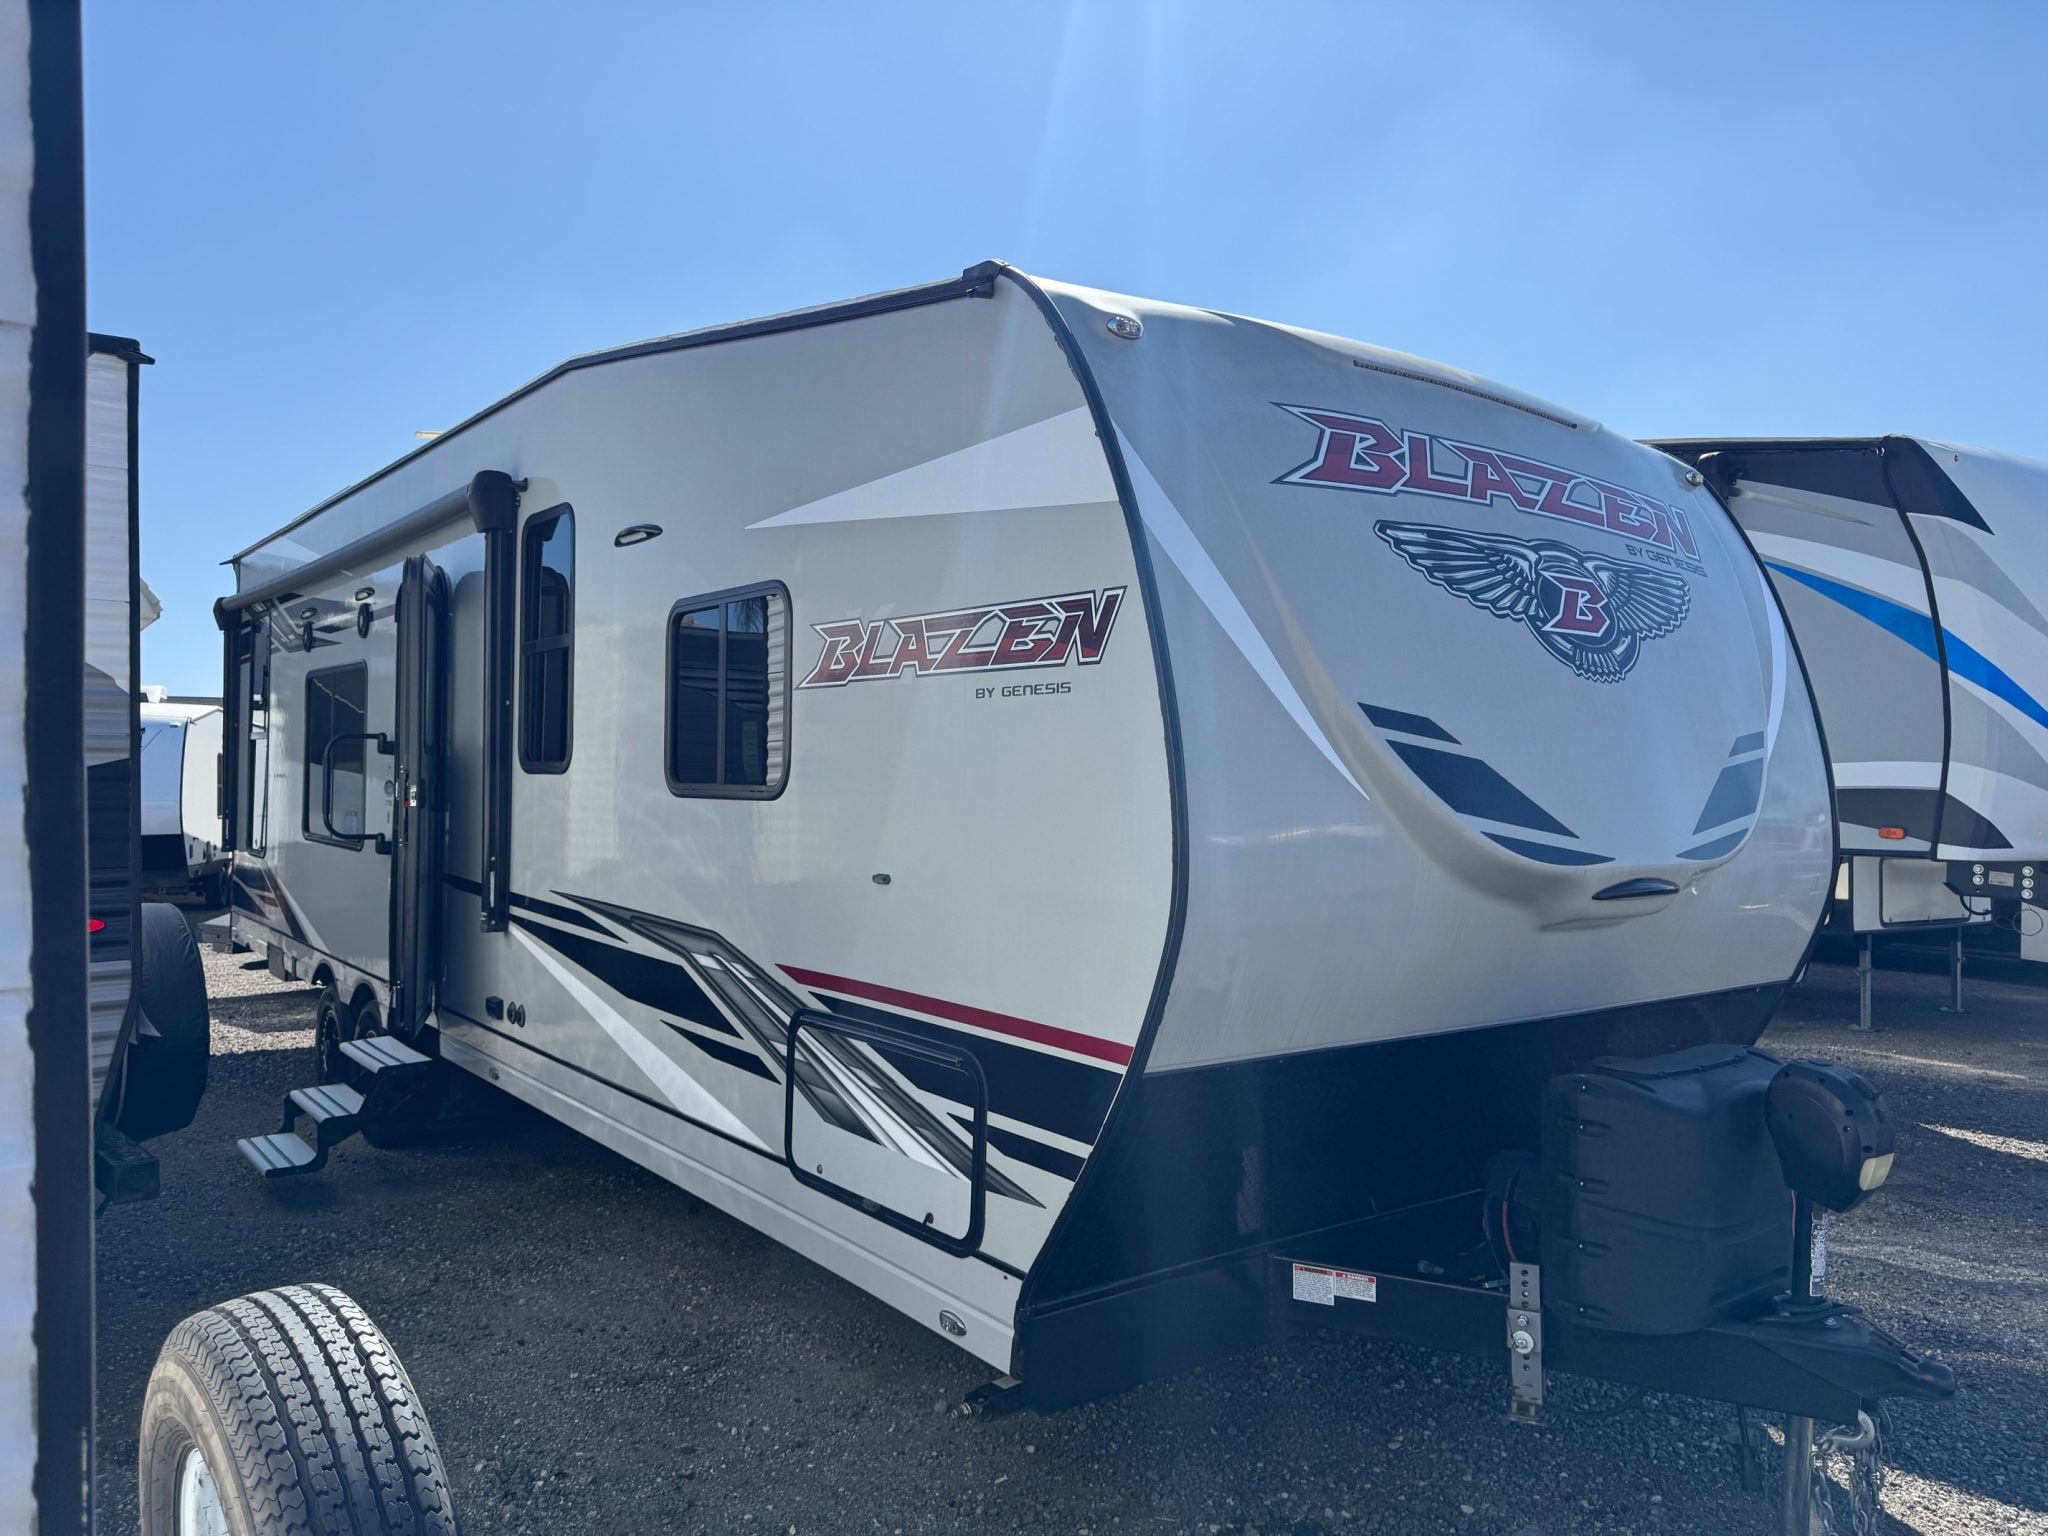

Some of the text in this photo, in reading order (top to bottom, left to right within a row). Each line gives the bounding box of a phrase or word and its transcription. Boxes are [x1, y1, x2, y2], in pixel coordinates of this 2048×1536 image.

[1269, 402, 1702, 564] BLAZEN
[1625, 543, 1708, 578] BY GENESIS
[794, 585, 1128, 690] BLAZEN
[1538, 570, 1610, 638] B
[975, 681, 1072, 700] BY GENESIS
